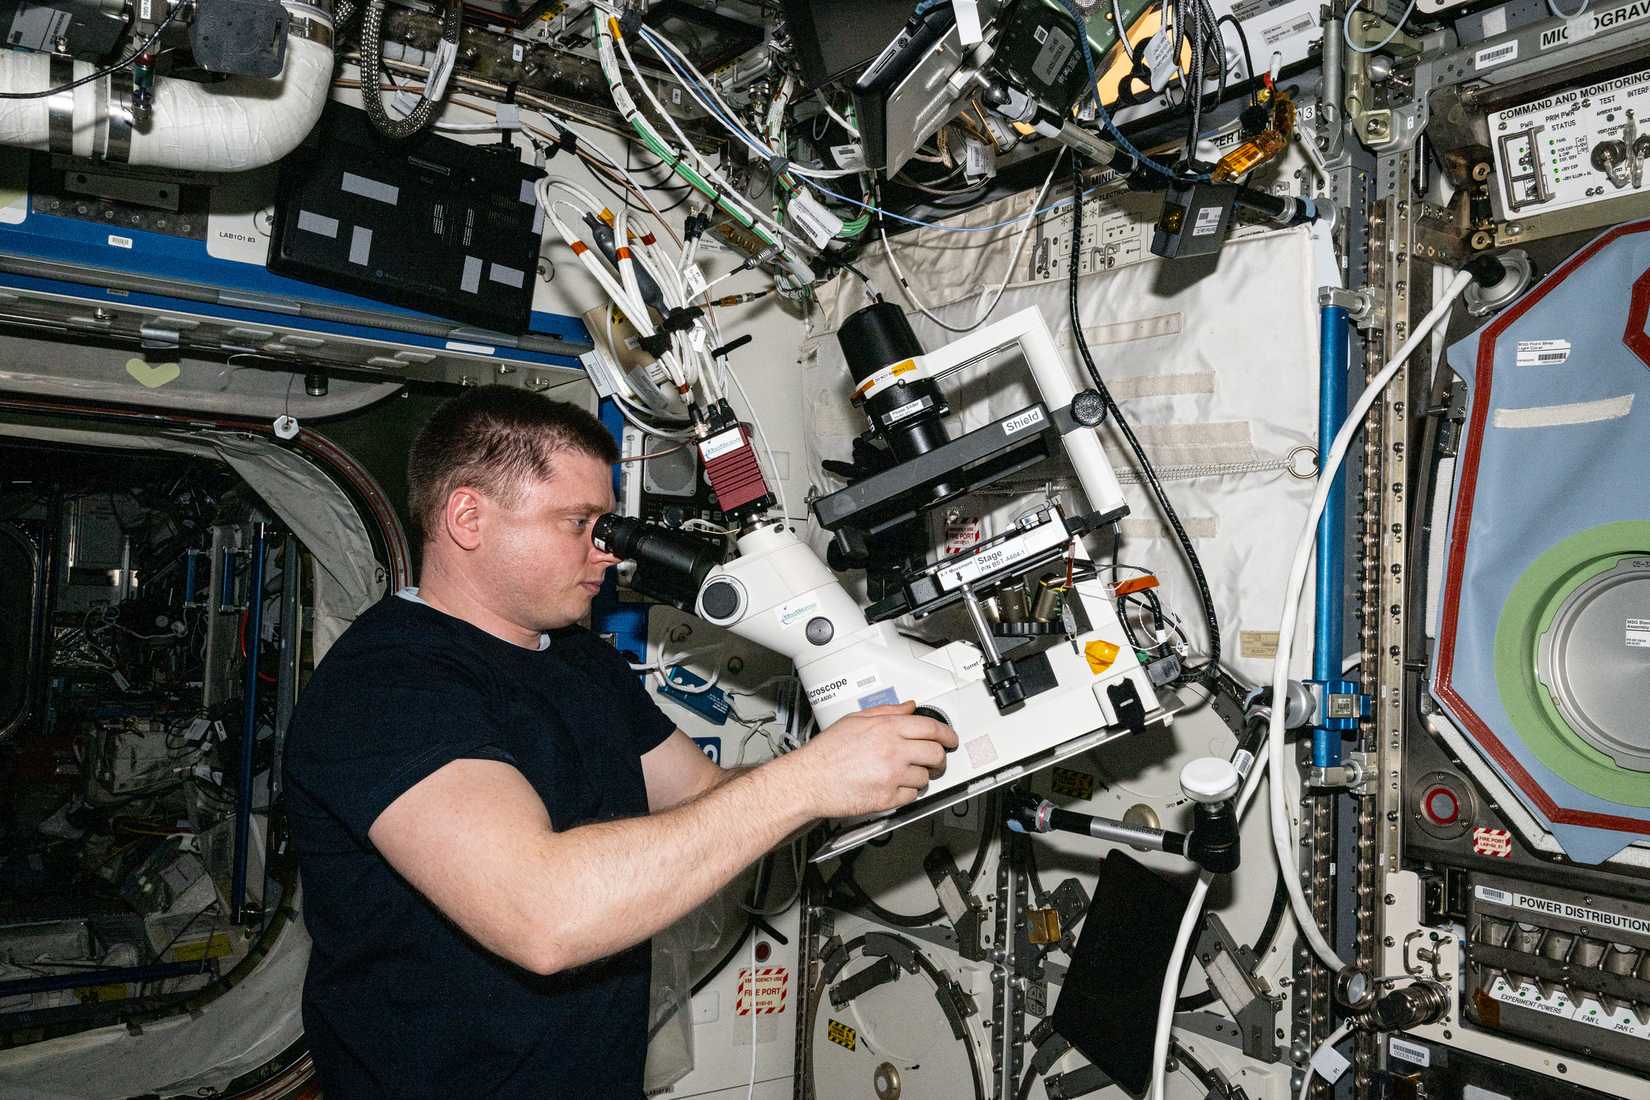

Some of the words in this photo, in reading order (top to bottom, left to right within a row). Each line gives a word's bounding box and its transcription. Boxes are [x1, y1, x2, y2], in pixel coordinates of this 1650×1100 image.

[1499, 99, 1553, 121] COMMAND
[1555, 92, 1577, 108] AND
[1580, 71, 1650, 98] MONITORING
[1600, 95, 1615, 105] TEST
[1545, 113, 1560, 123] PRIM
[1561, 109, 1575, 119] PWR
[1520, 121, 1534, 129] PWR
[1551, 120, 1577, 132] STATUS
[1005, 411, 1040, 433] Shield
[978, 550, 1002, 564] Stage
[963, 660, 980, 672] Turret
[1519, 896, 1562, 914] POWER
[1565, 905, 1650, 933] DISTRIBUTION
[761, 987, 781, 996] PORT
[1500, 993, 1536, 1009] EXPERIMENT
[1537, 1003, 1562, 1014] POWERS
[1581, 1015, 1594, 1023] FAN
[1614, 1023, 1628, 1032] FAN
